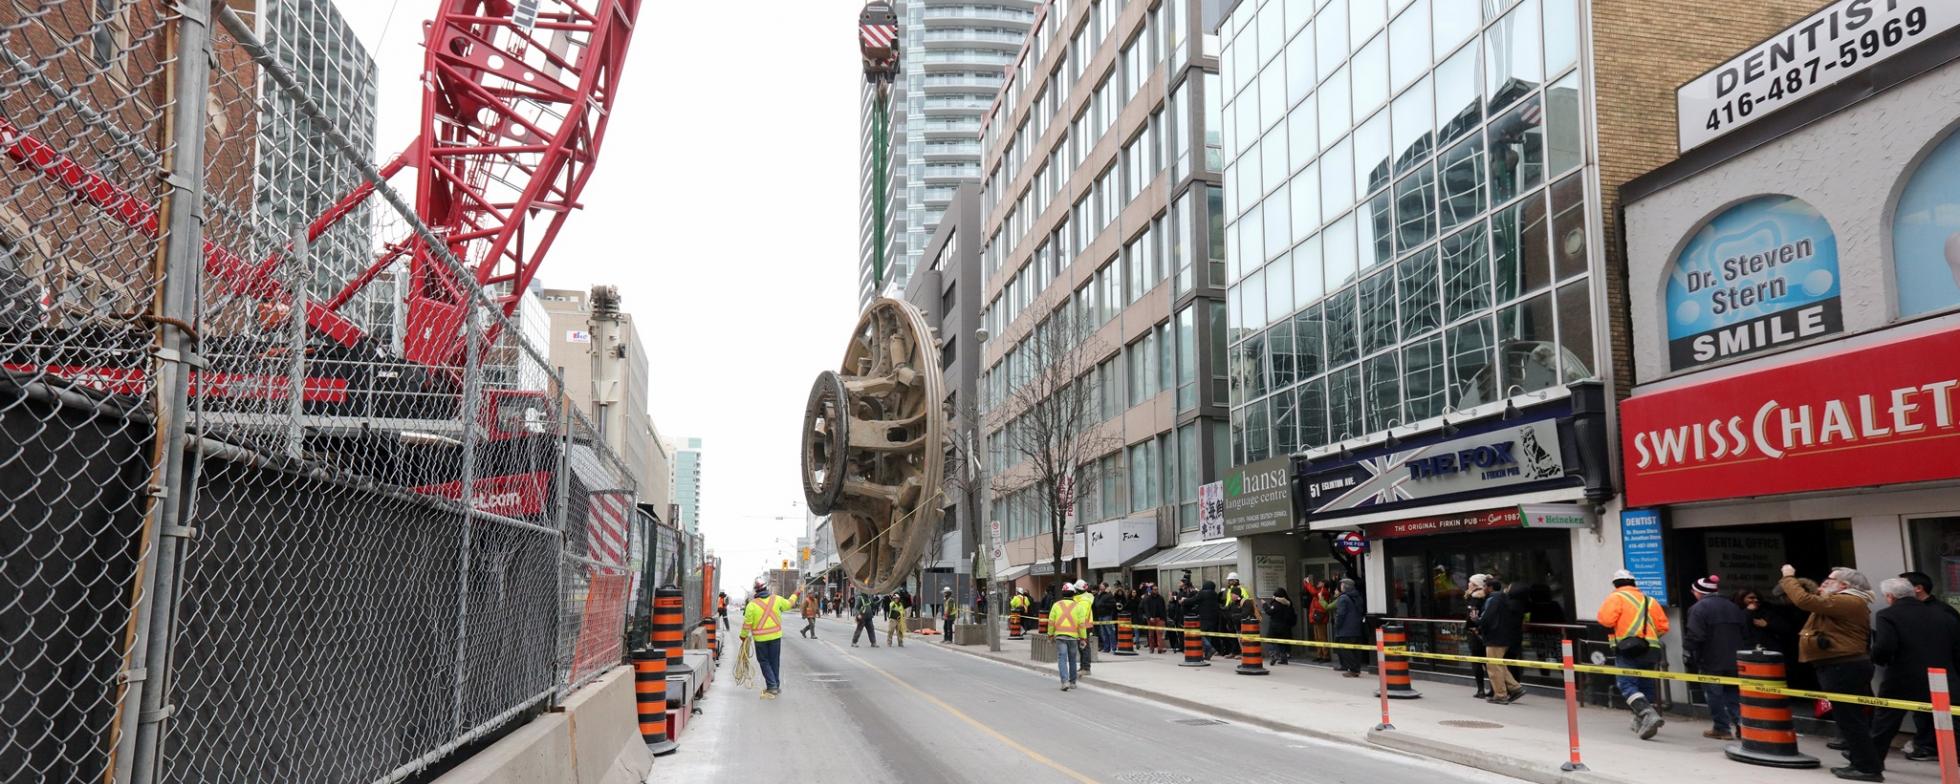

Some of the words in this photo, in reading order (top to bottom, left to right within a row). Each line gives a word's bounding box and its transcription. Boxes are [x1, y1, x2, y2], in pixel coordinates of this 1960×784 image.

[1706, 6, 1926, 131] 416-487-5969
[1687, 270, 1717, 293] Dr.
[1723, 238, 1812, 281] Steven
[1712, 277, 1786, 315] Stern
[1692, 305, 1825, 362] SMILE
[1405, 453, 1458, 480] THE
[1458, 441, 1519, 473] FOX
[1242, 468, 1287, 494] hansa
[1310, 483, 1320, 498] 51
[1226, 495, 1259, 510] language
[1260, 490, 1287, 503] centre
[1407, 522, 1437, 531] ORIGINAL
[1440, 519, 1460, 528] FIRKIN
[1463, 517, 1478, 525] PUB
[1504, 513, 1521, 521] 1987
[1545, 515, 1585, 524] Heineken
[1626, 516, 1657, 527] DENTIST
